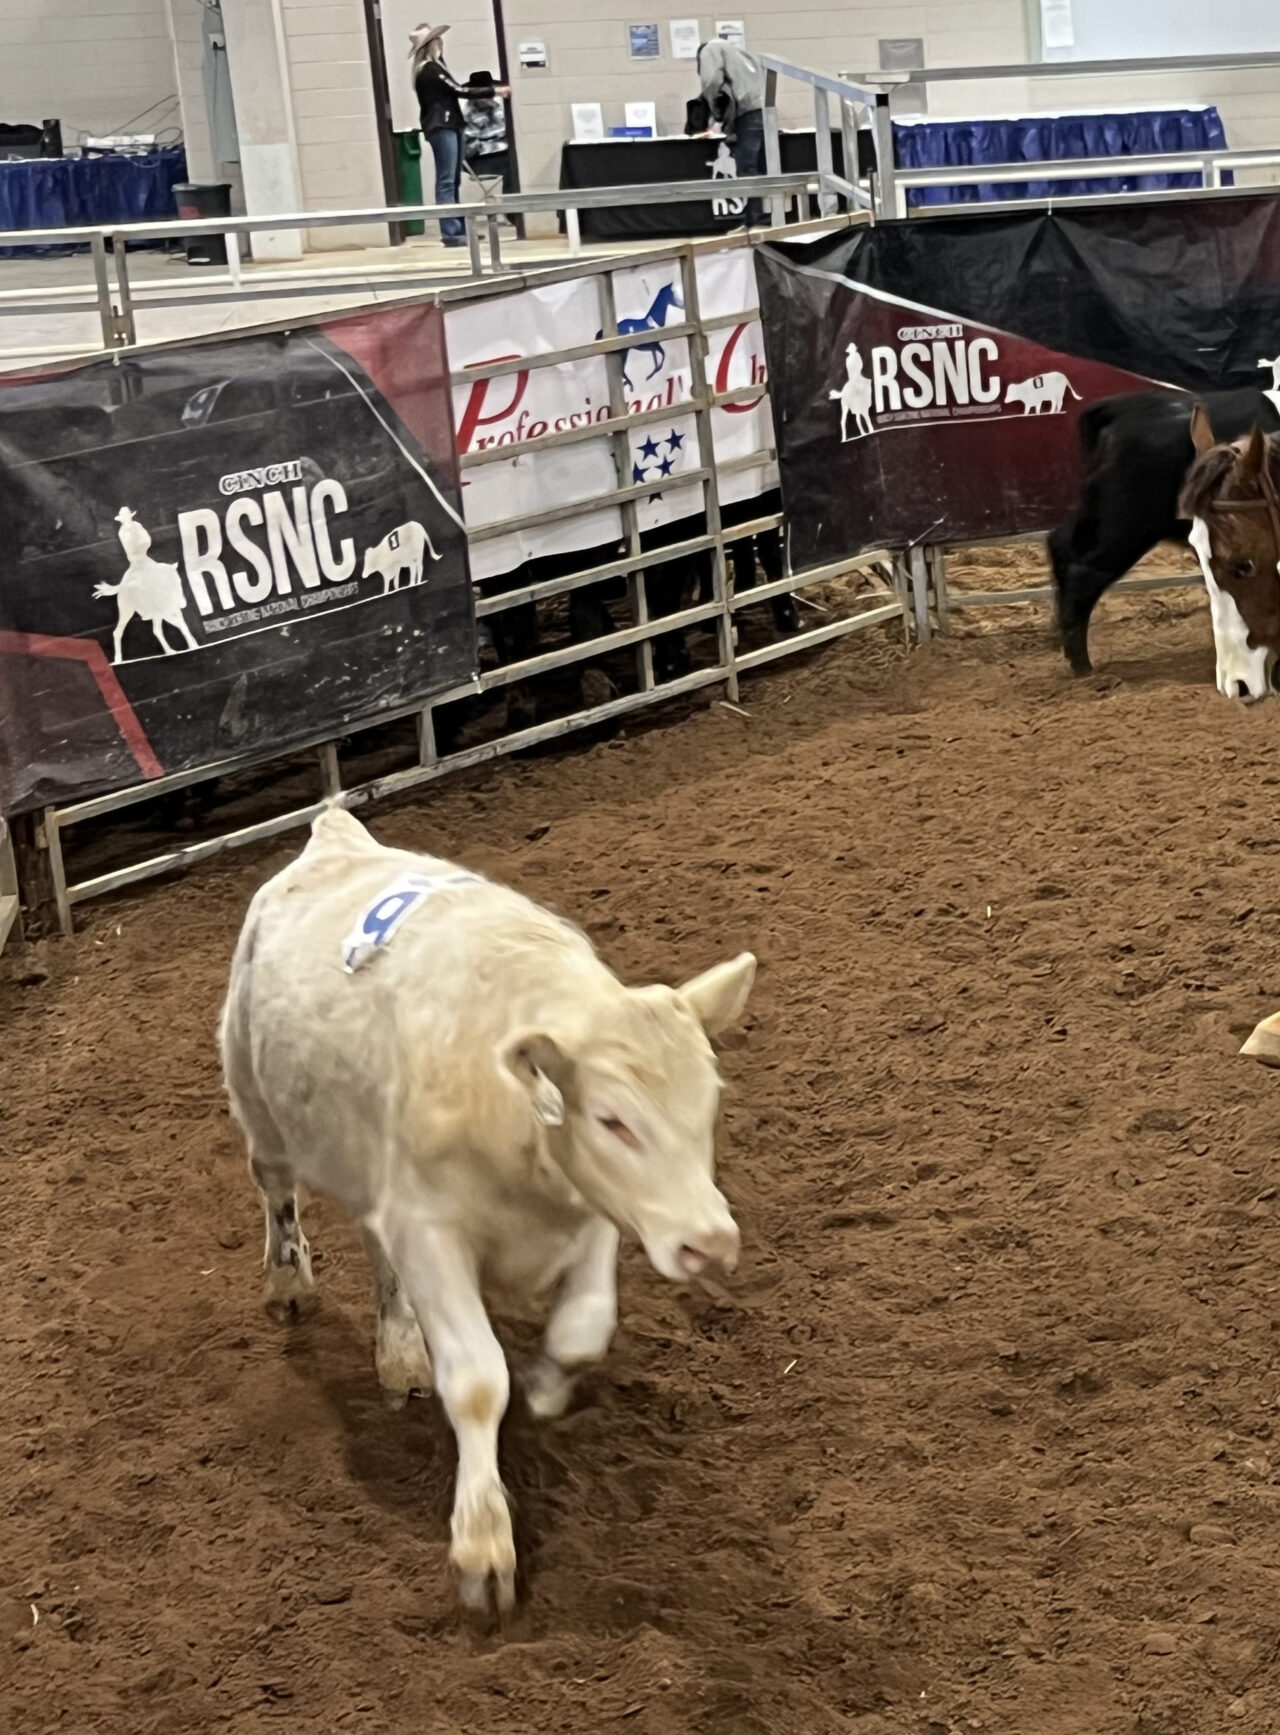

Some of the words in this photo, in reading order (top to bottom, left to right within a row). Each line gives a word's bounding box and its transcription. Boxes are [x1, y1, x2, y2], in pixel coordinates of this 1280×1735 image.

[871, 338, 1001, 413] RSNC
[219, 460, 302, 495] CINCH
[178, 479, 356, 616] RSNC
